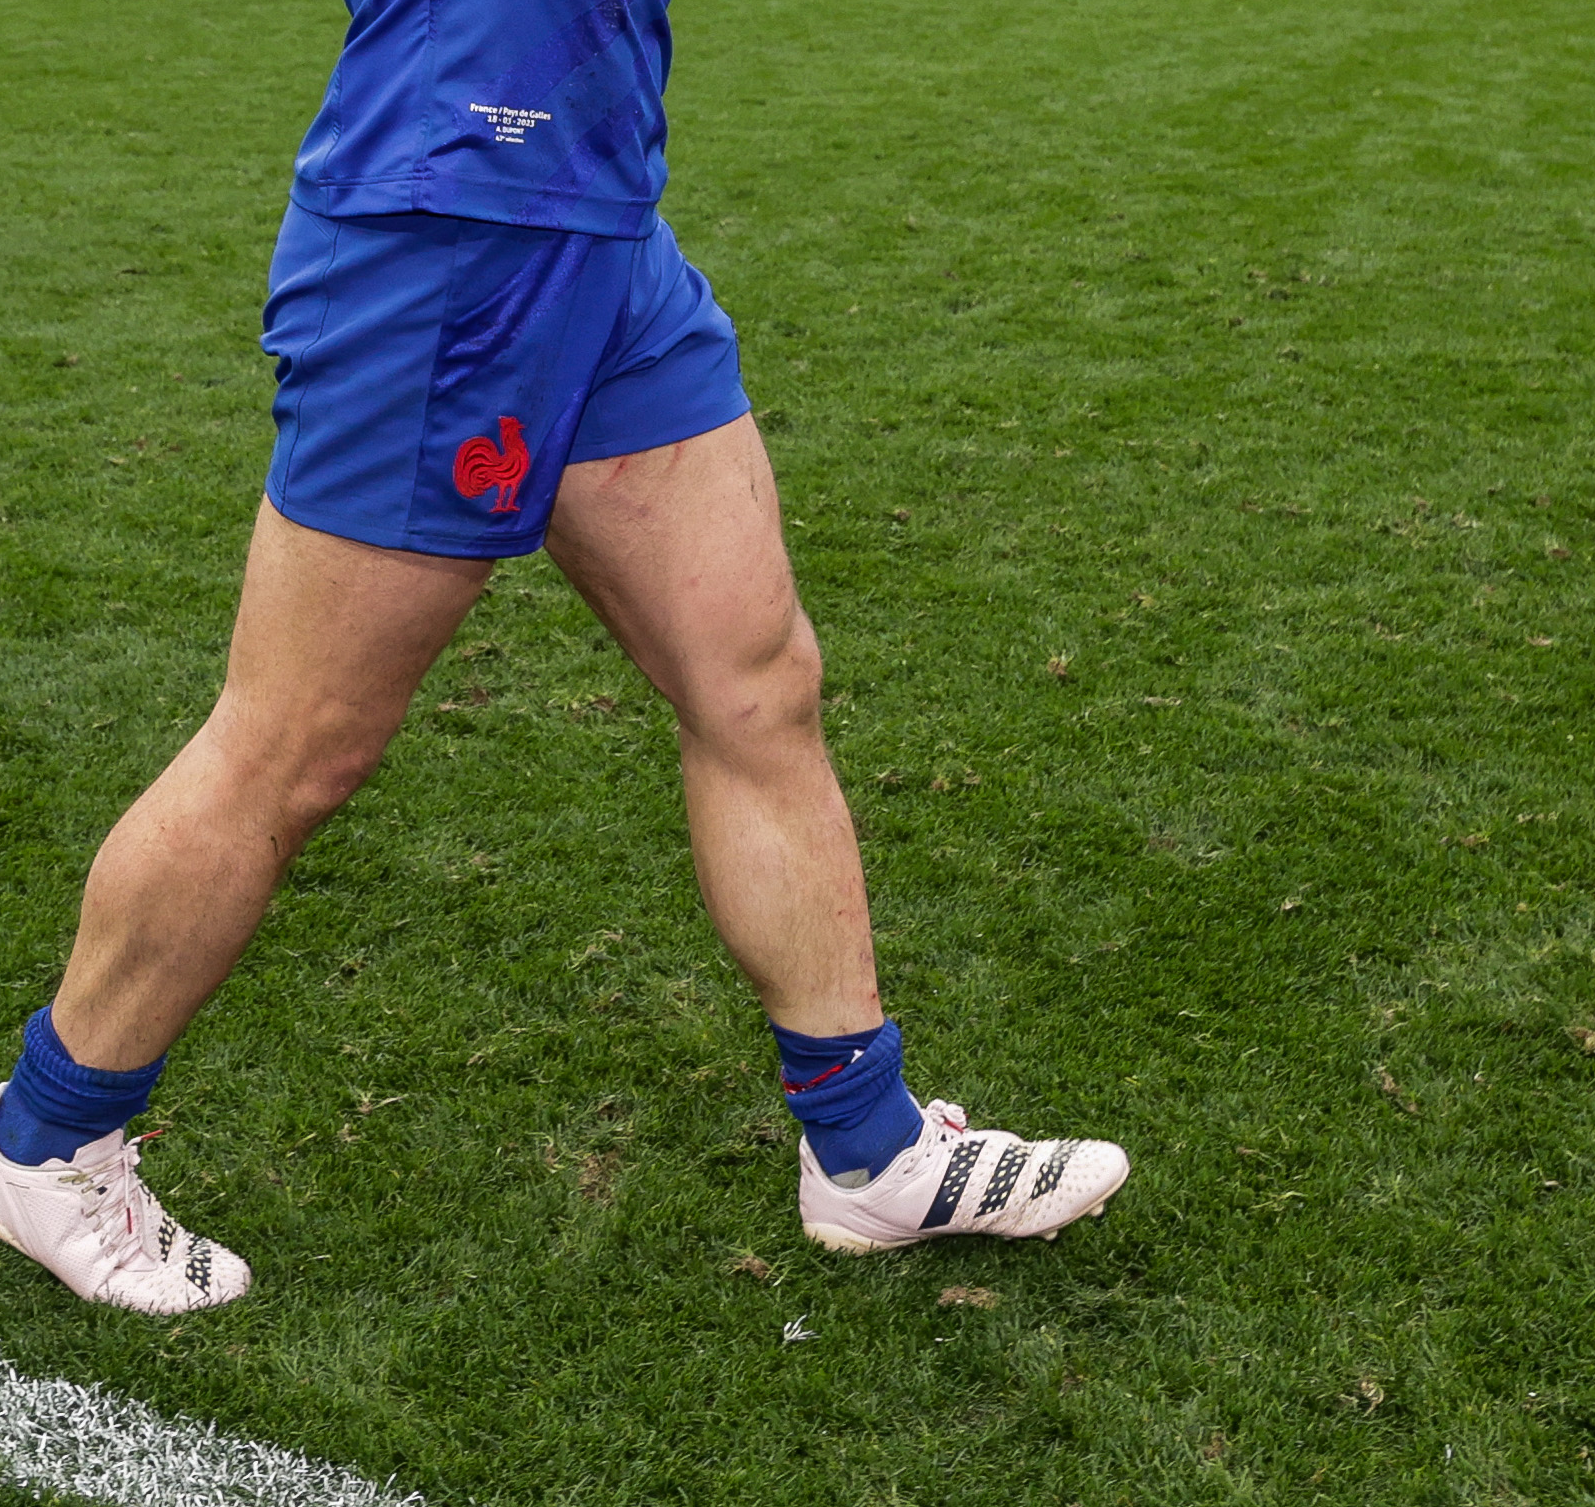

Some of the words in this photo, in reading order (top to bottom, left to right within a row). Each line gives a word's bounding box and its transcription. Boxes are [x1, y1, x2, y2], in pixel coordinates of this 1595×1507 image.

[470, 103, 498, 114] France
[503, 108, 518, 118] Pays
[519, 109, 528, 117] de
[529, 110, 551, 121] Galles
